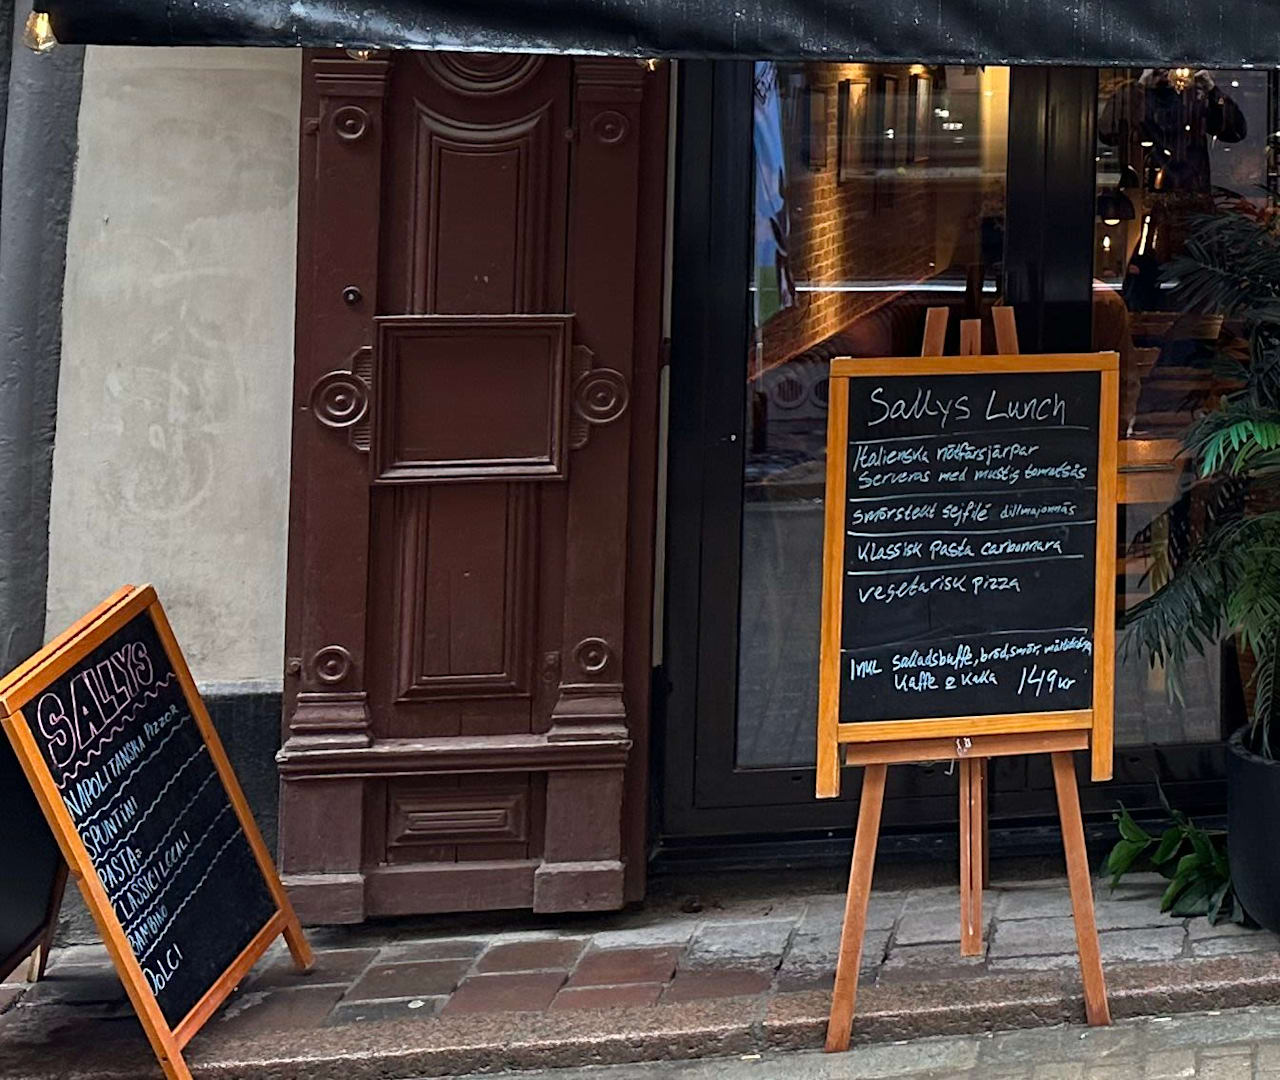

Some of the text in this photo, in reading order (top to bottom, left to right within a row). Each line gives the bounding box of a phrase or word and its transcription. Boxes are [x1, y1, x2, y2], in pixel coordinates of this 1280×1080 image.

[868, 387, 1067, 428] Sallys Lunch
[938, 466, 966, 482] med
[36, 641, 154, 769] SALLYS
[62, 735, 147, 822] NAPOLITANSKA
